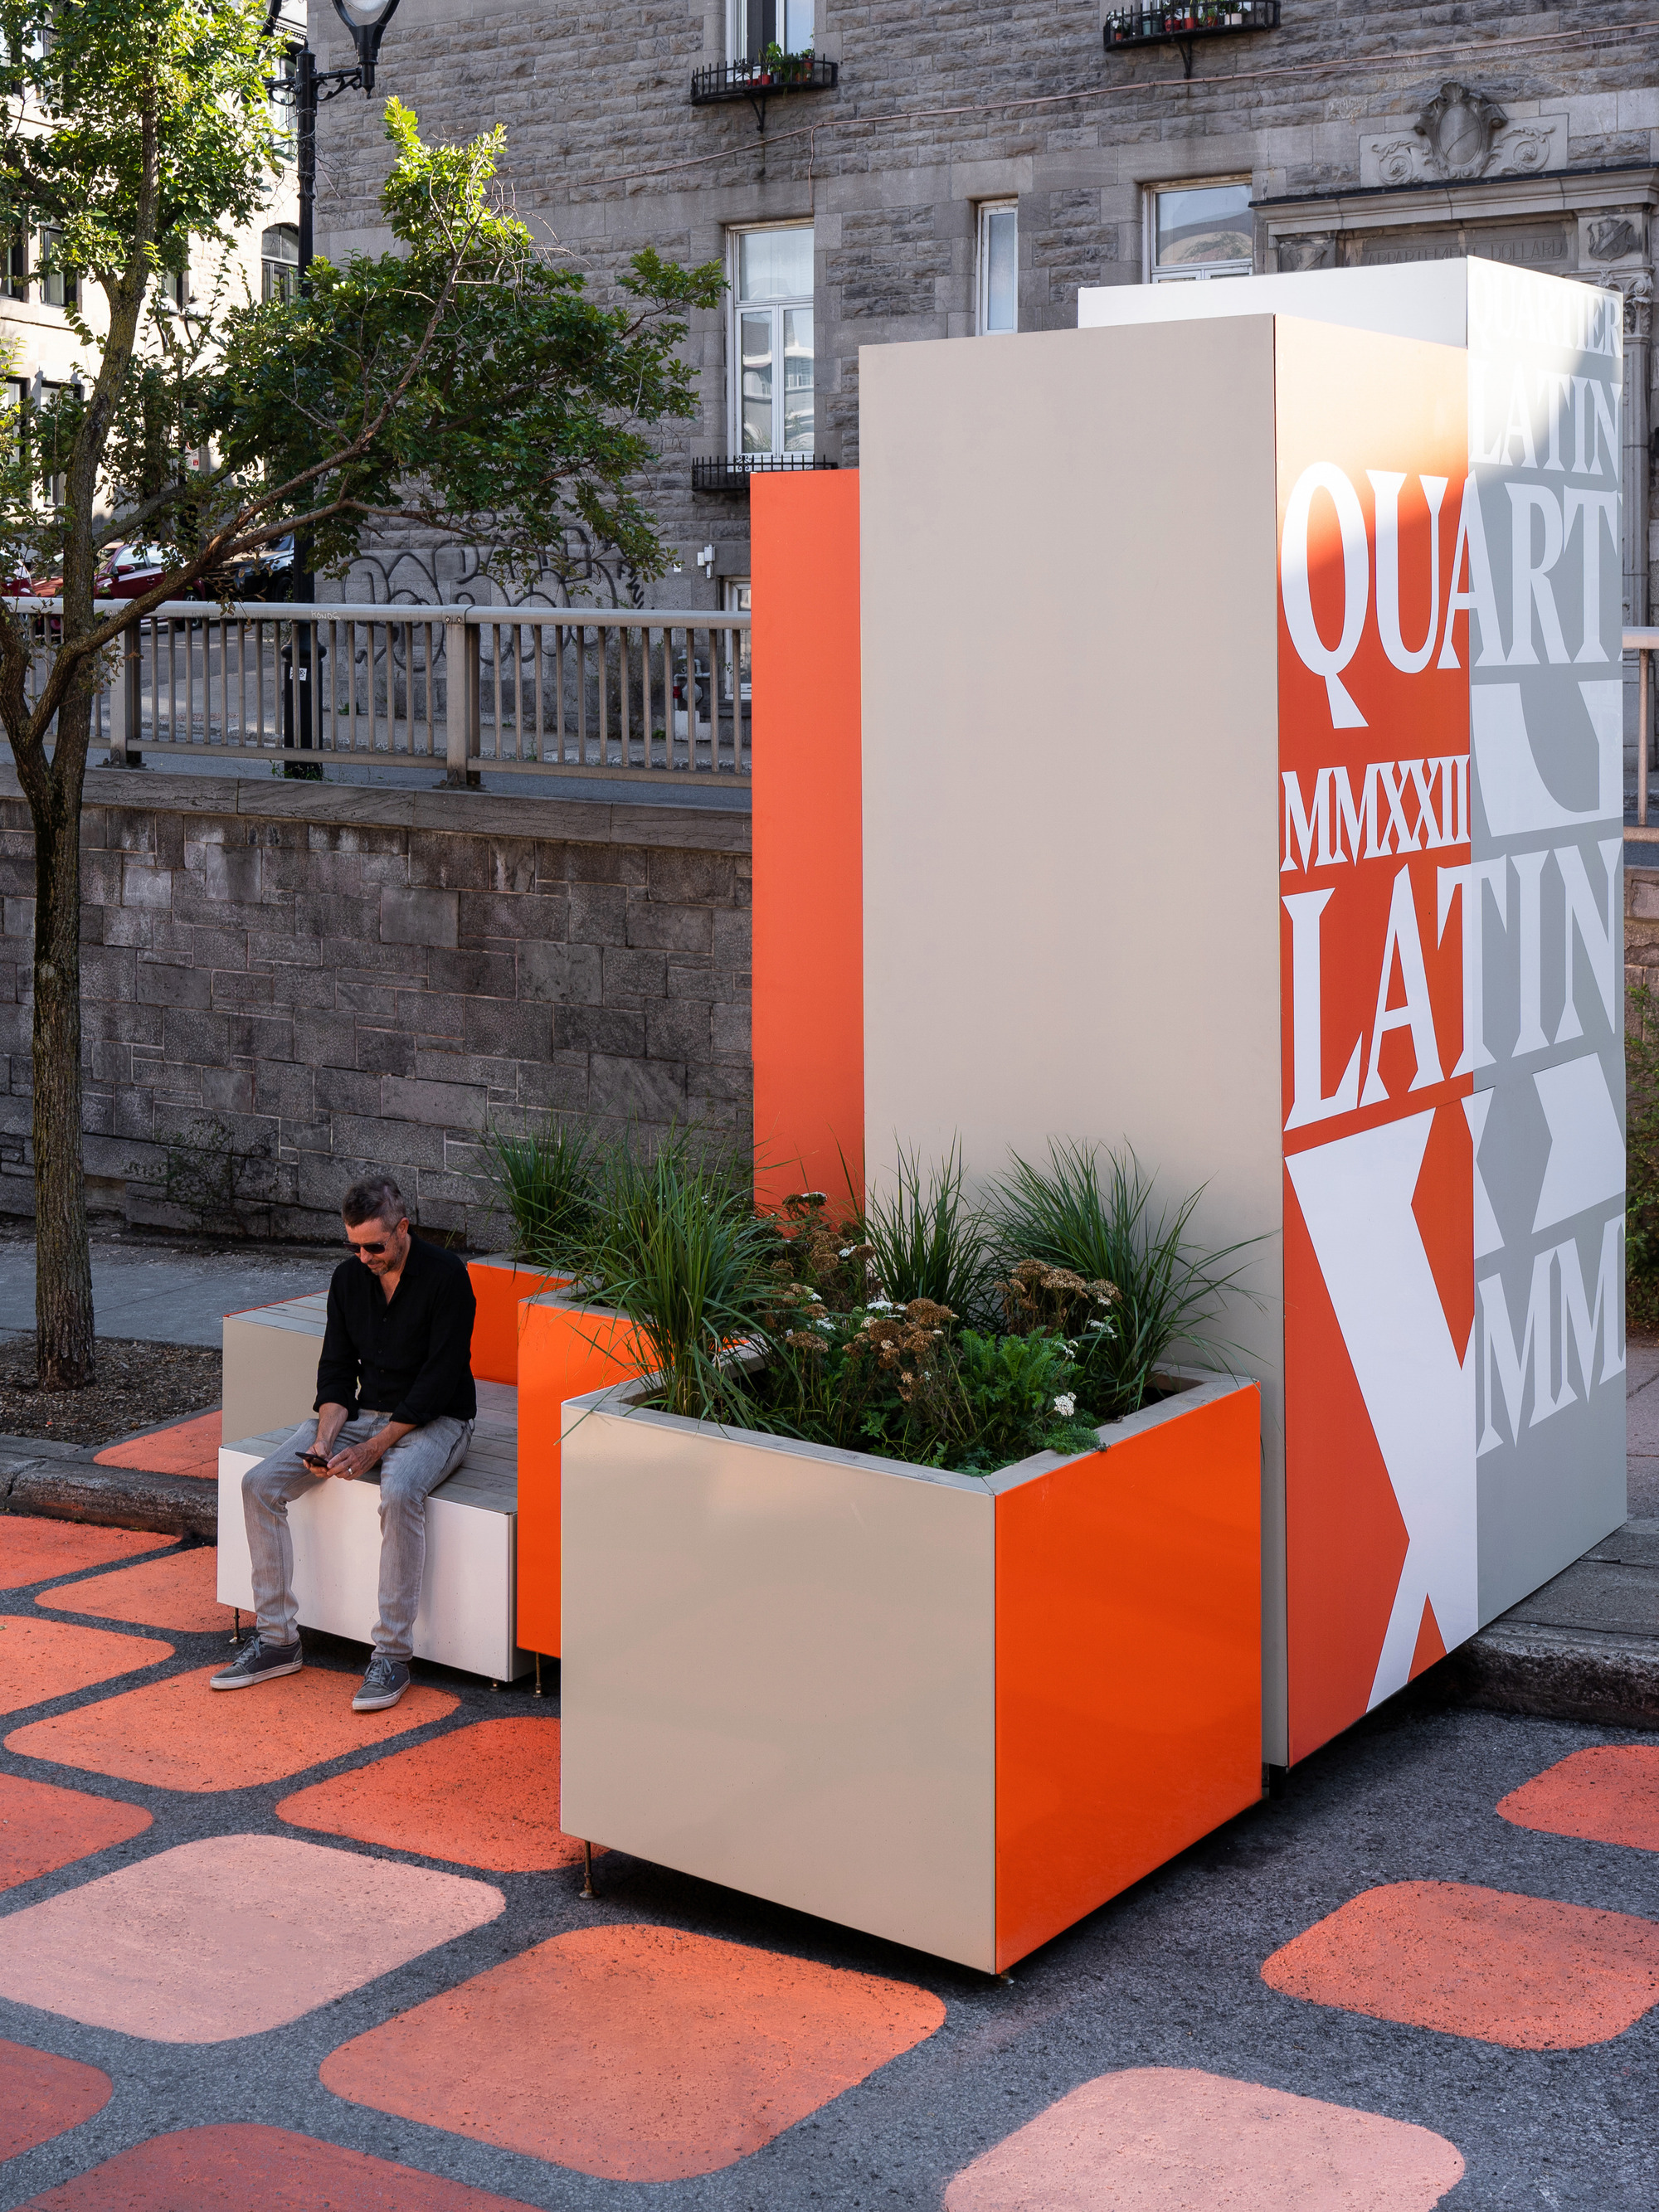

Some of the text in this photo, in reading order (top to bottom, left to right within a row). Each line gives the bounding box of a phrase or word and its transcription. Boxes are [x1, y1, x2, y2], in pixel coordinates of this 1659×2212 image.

[1470, 264, 1622, 358] QUARTIER
[1491, 239, 1563, 261] DOLLARD
[1470, 358, 1623, 483] LATIN
[1281, 461, 1623, 729] QUART
[1280, 755, 1472, 874] MMXXII
[1281, 837, 1623, 1132] LATIN
